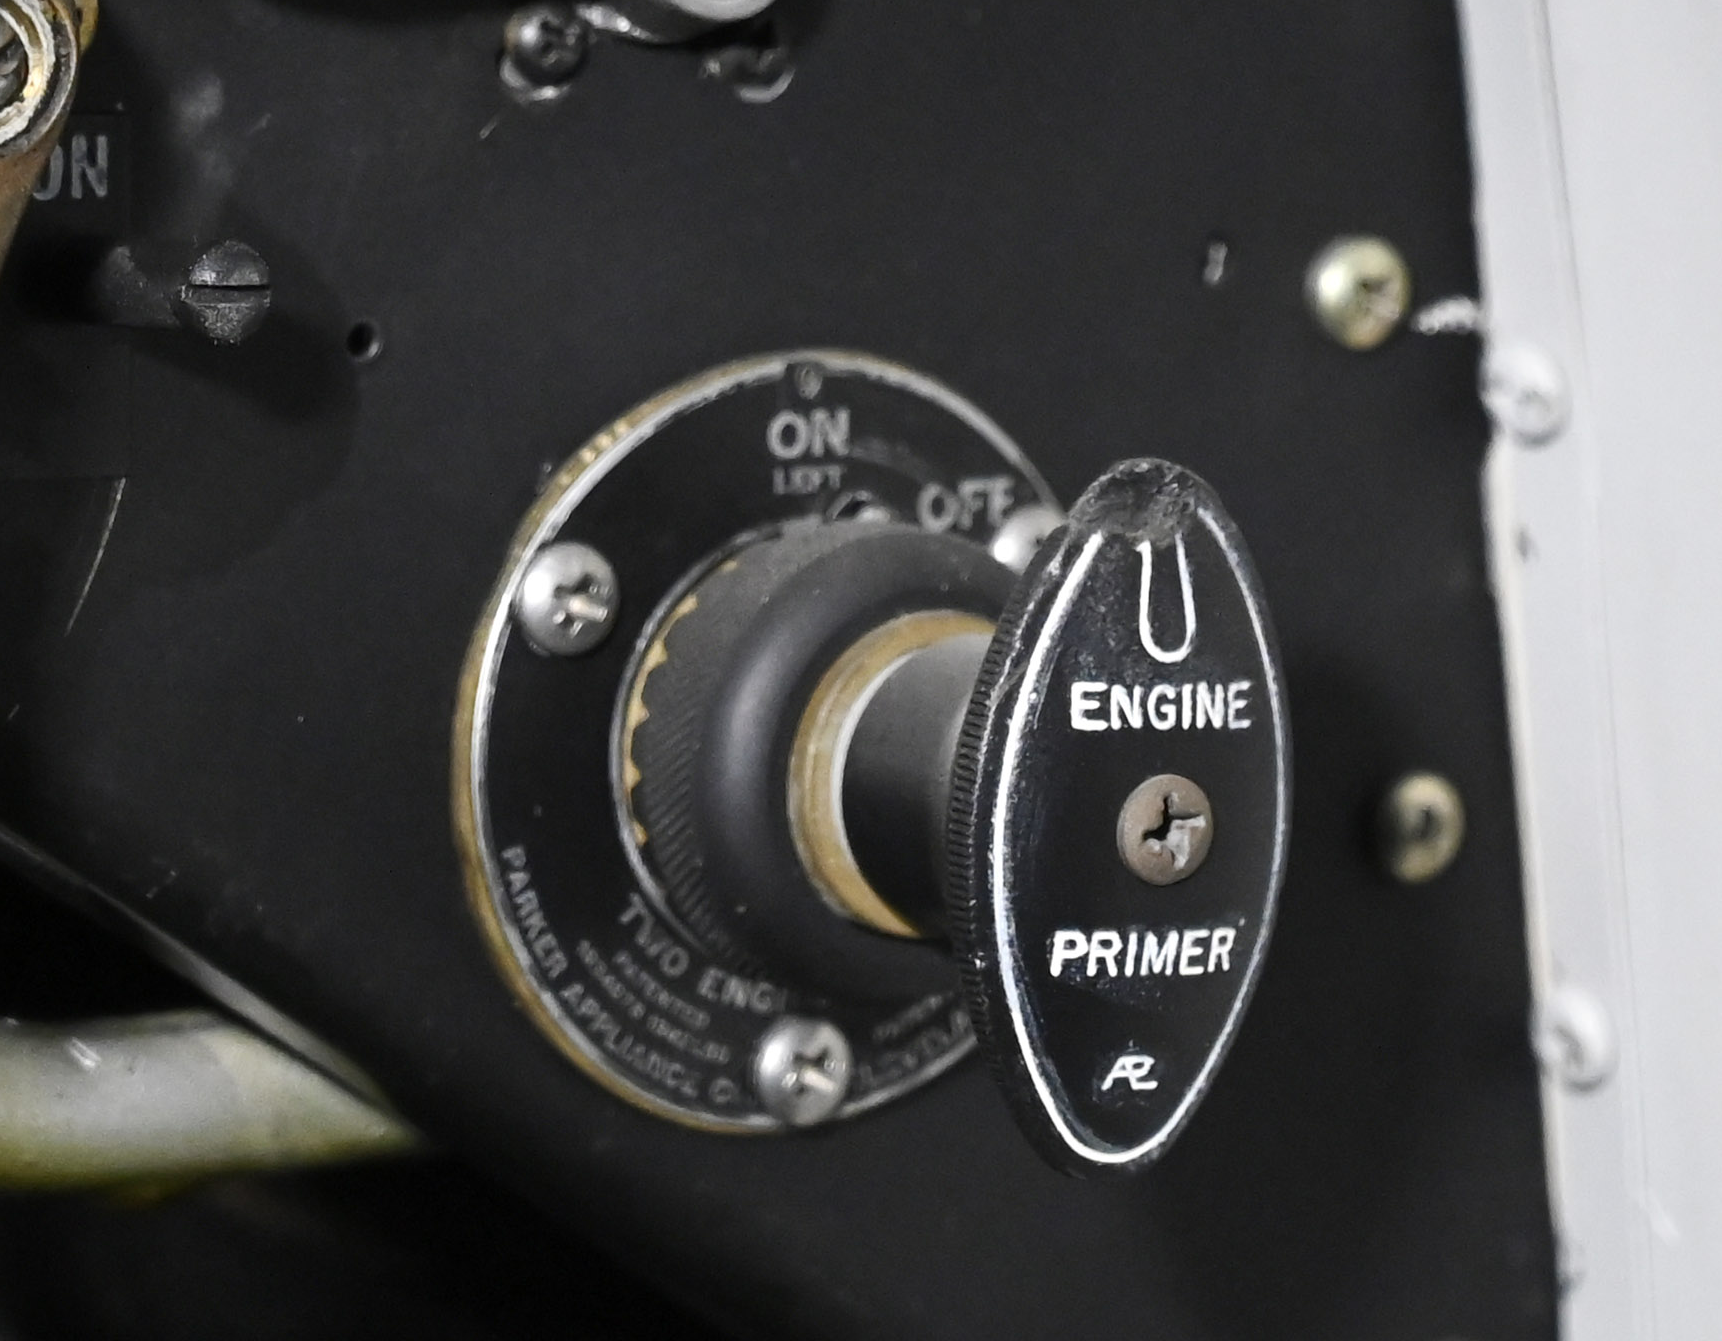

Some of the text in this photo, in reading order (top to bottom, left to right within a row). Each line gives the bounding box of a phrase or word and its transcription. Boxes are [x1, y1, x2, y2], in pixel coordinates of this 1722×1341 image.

[766, 408, 851, 459] ON
[916, 474, 1016, 535] OFF
[1069, 679, 1251, 733] ENGINE
[501, 845, 568, 980] PARKER
[618, 892, 690, 977] TWO
[1050, 925, 1237, 978] PRIMER
